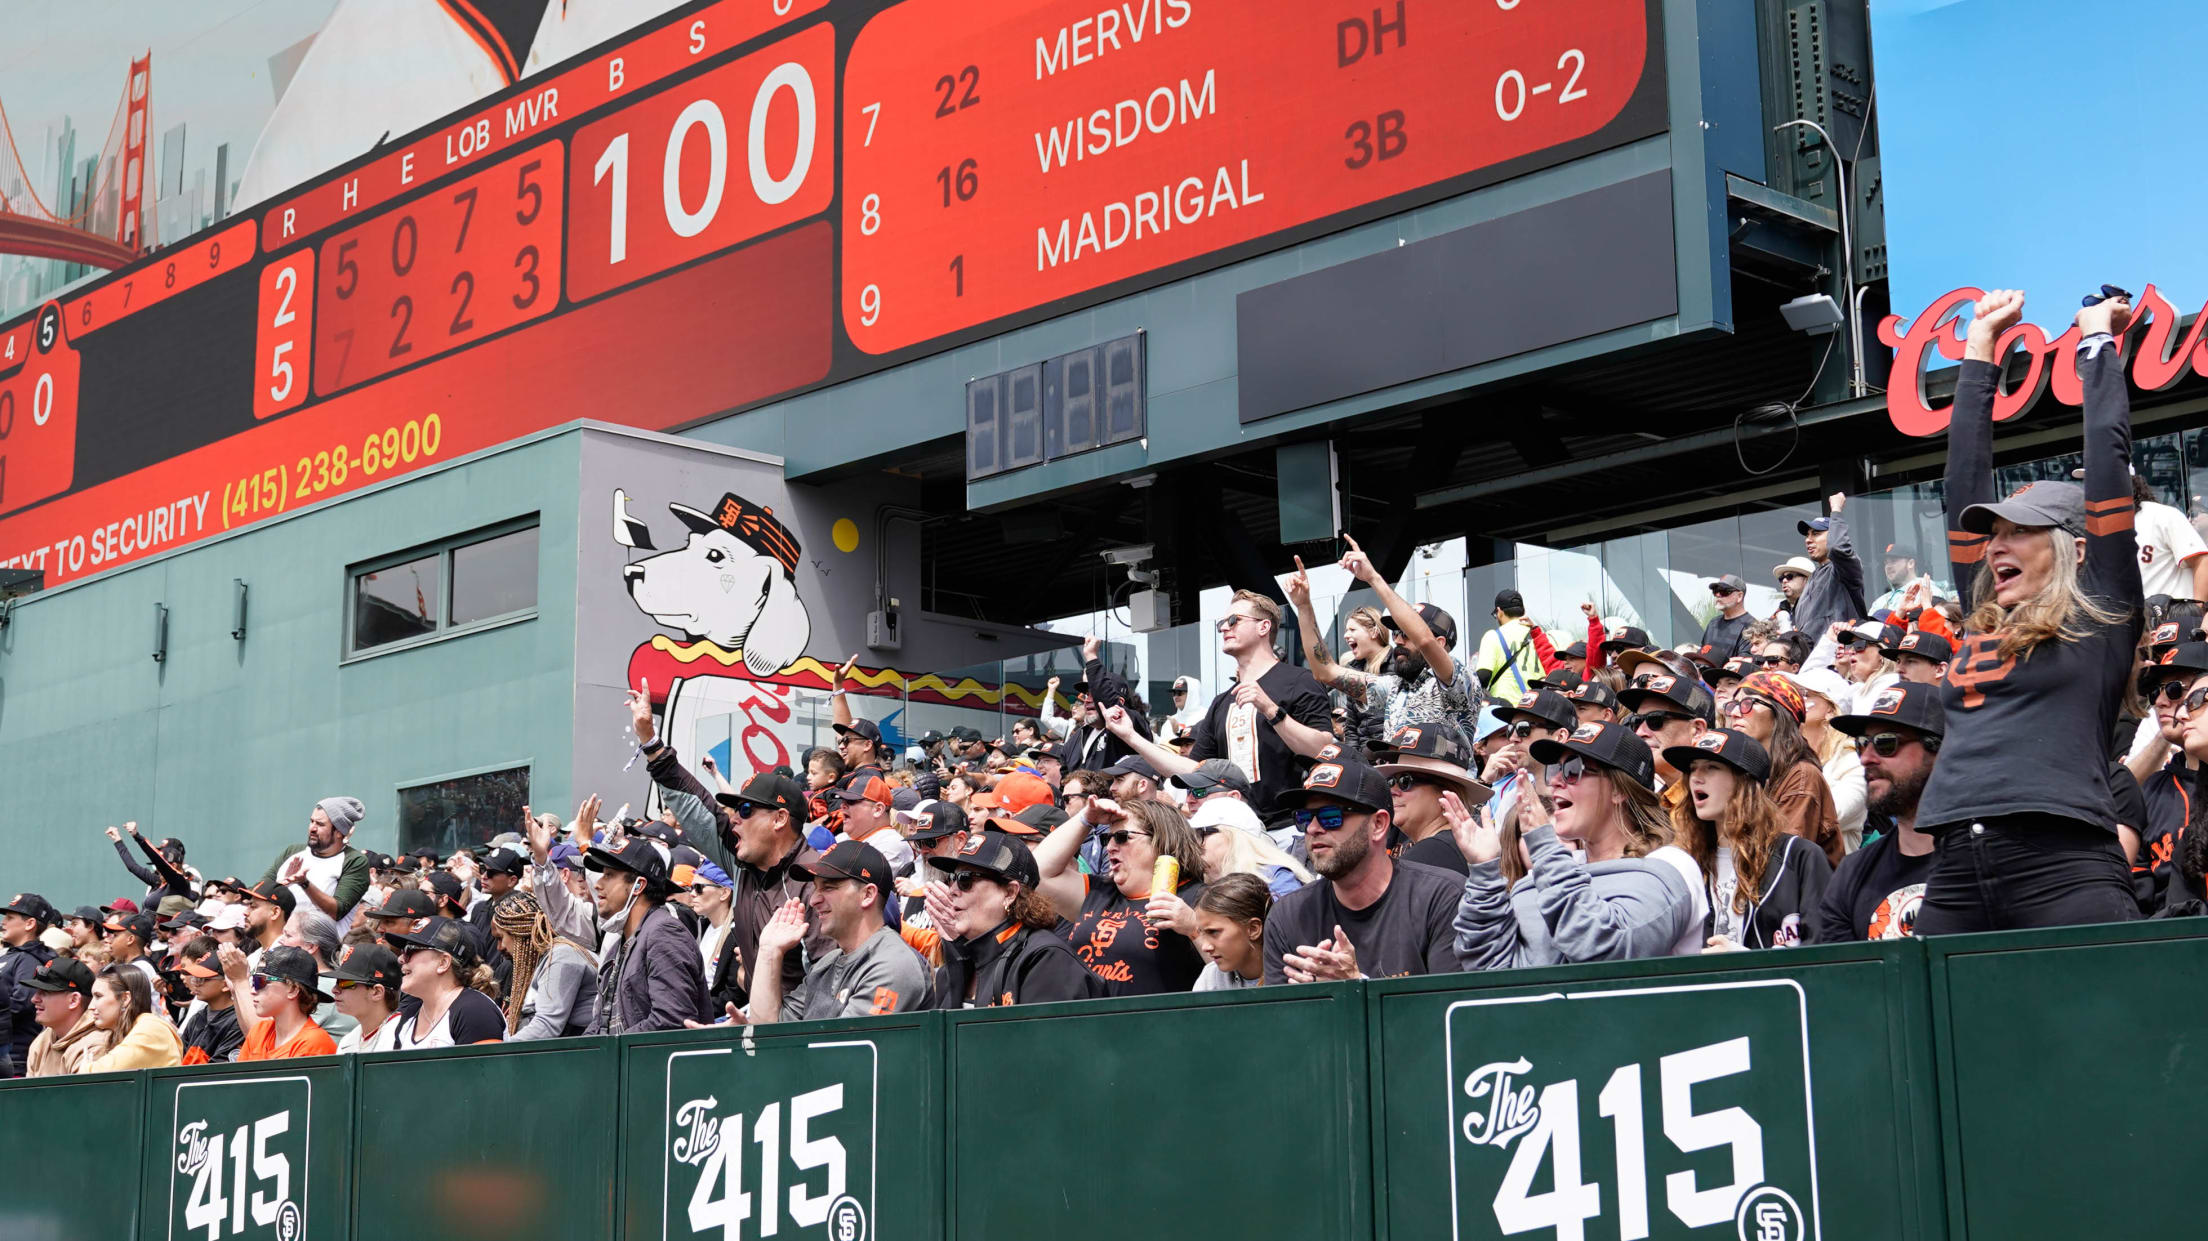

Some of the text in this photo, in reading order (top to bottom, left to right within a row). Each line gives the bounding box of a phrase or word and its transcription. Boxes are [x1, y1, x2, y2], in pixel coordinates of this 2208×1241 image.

[609, 21, 705, 91] B S
[861, 2, 1407, 235] 8 16 WISDOM DH
[862, 0, 1191, 146] 7 22 MERVIS
[283, 88, 559, 238] R H E LOB MVR
[861, 49, 1588, 326] 9 1 MADRIGAL 3B 0-2
[5, 242, 220, 360] 4 5 6 7 8 9
[274, 160, 543, 328] 2 5 0 7 5
[271, 244, 541, 402] 5 7 2 2 3
[1877, 283, 2208, 437] Cor
[33, 373, 53, 426] 0
[55, 536, 85, 577] TO
[91, 491, 210, 564] SECURITY
[222, 465, 287, 528] (415)
[296, 413, 441, 498] 238-6900
[178, 1118, 209, 1177] The
[185, 1110, 290, 1241] 415
[674, 1094, 722, 1167] The
[687, 1083, 847, 1241] 415
[1463, 1056, 1541, 1149] The
[1493, 1036, 1765, 1241] 415
